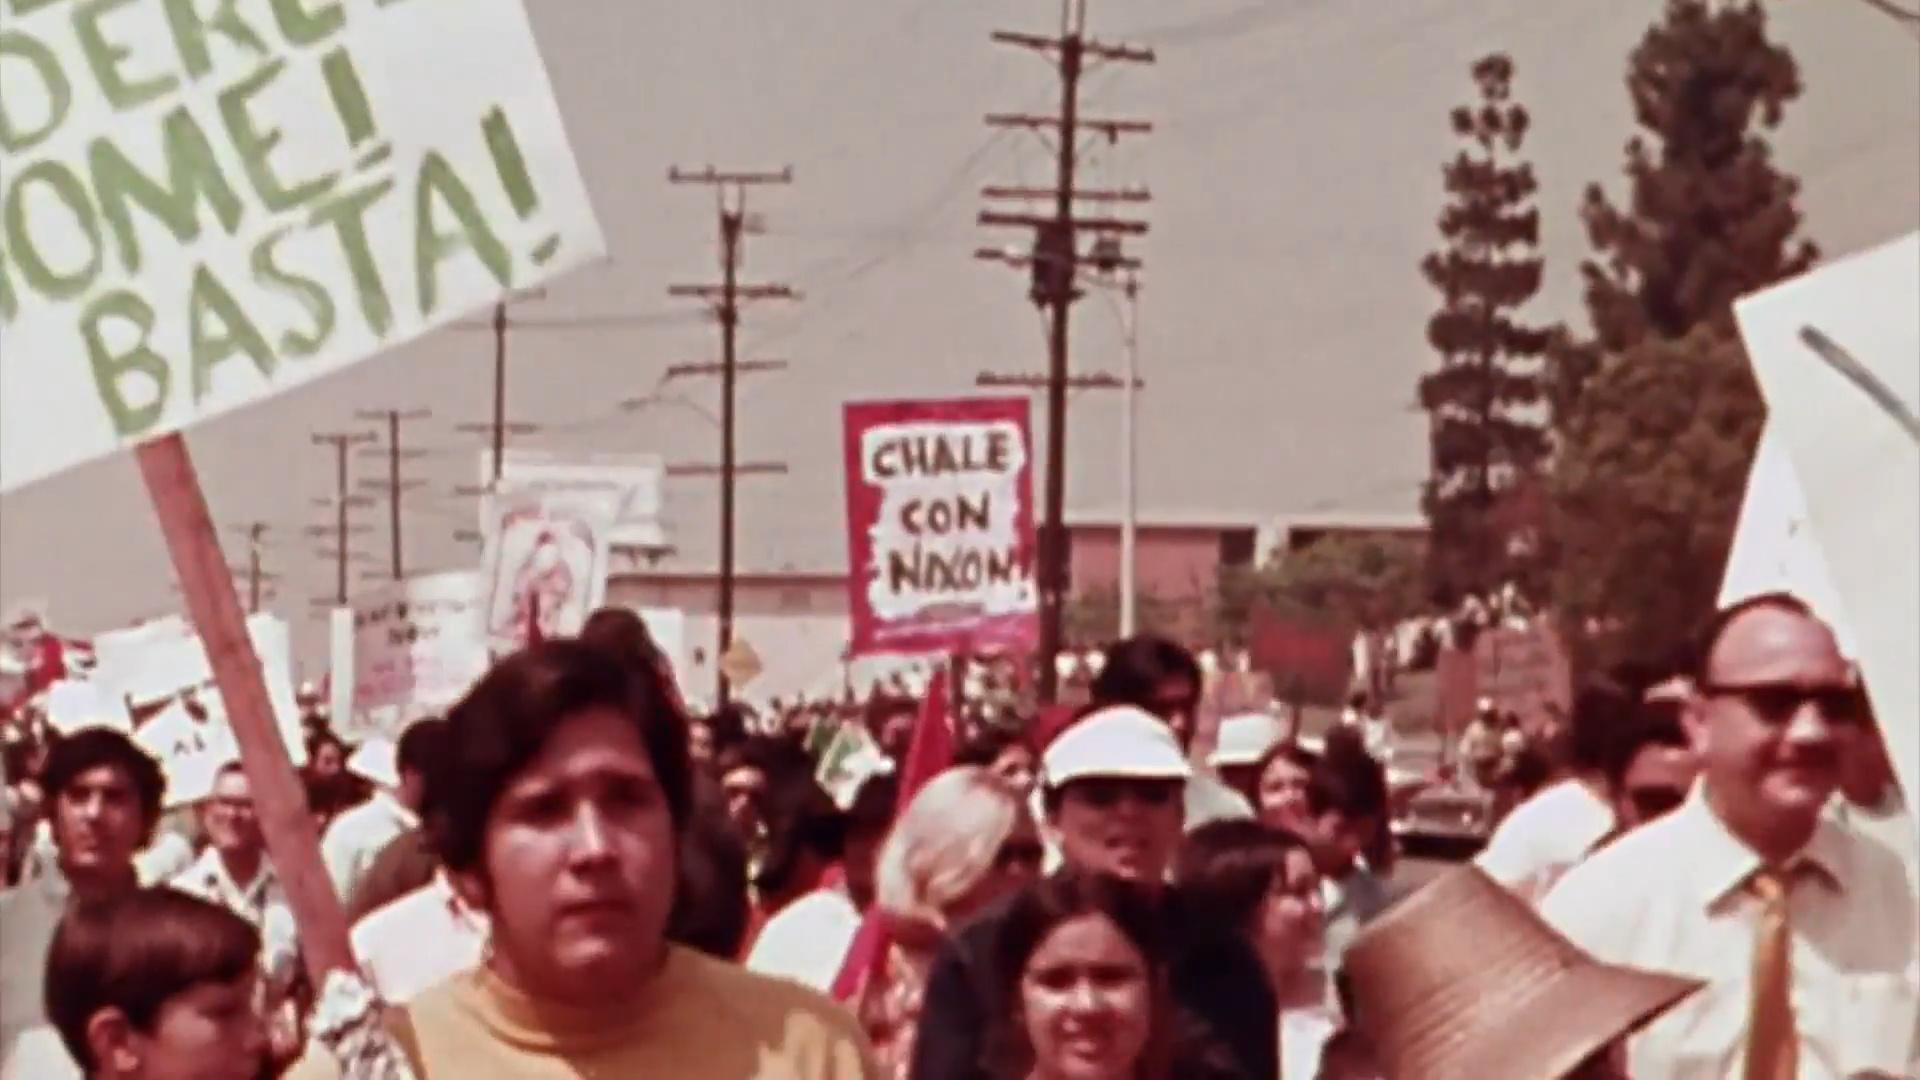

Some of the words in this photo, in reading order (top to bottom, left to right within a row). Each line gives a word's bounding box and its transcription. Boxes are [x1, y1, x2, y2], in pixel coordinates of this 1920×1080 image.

[0, 41, 392, 323] OME!
[80, 104, 560, 436] BASTA!
[871, 431, 1009, 478] CHALE
[901, 491, 990, 534] CON
